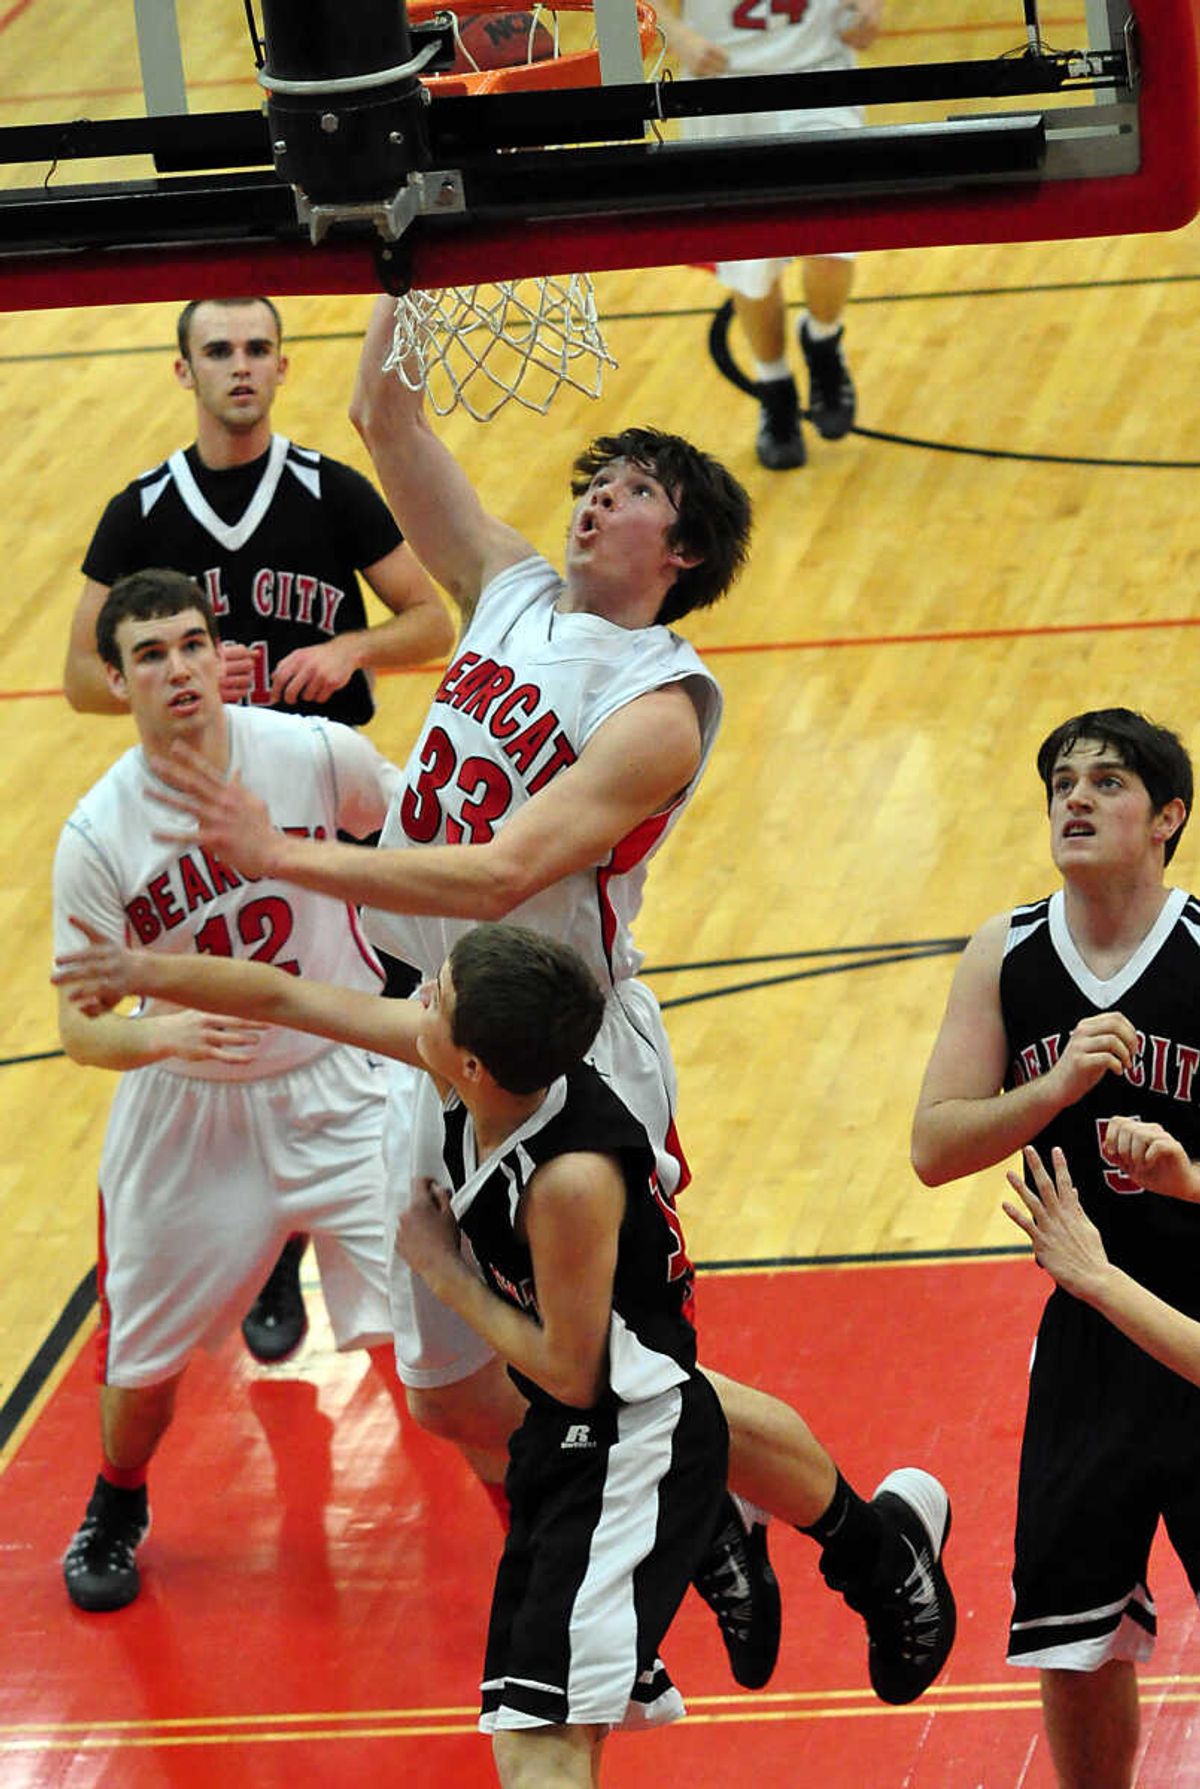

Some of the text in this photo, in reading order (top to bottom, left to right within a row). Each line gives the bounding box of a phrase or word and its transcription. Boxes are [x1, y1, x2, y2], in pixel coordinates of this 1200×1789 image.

[732, 0, 809, 30] 24
[253, 567, 345, 635] CITY
[435, 651, 578, 797] EARCAT
[401, 726, 512, 844] 33
[194, 895, 301, 976] 12
[1124, 1030, 1200, 1102] CIT
